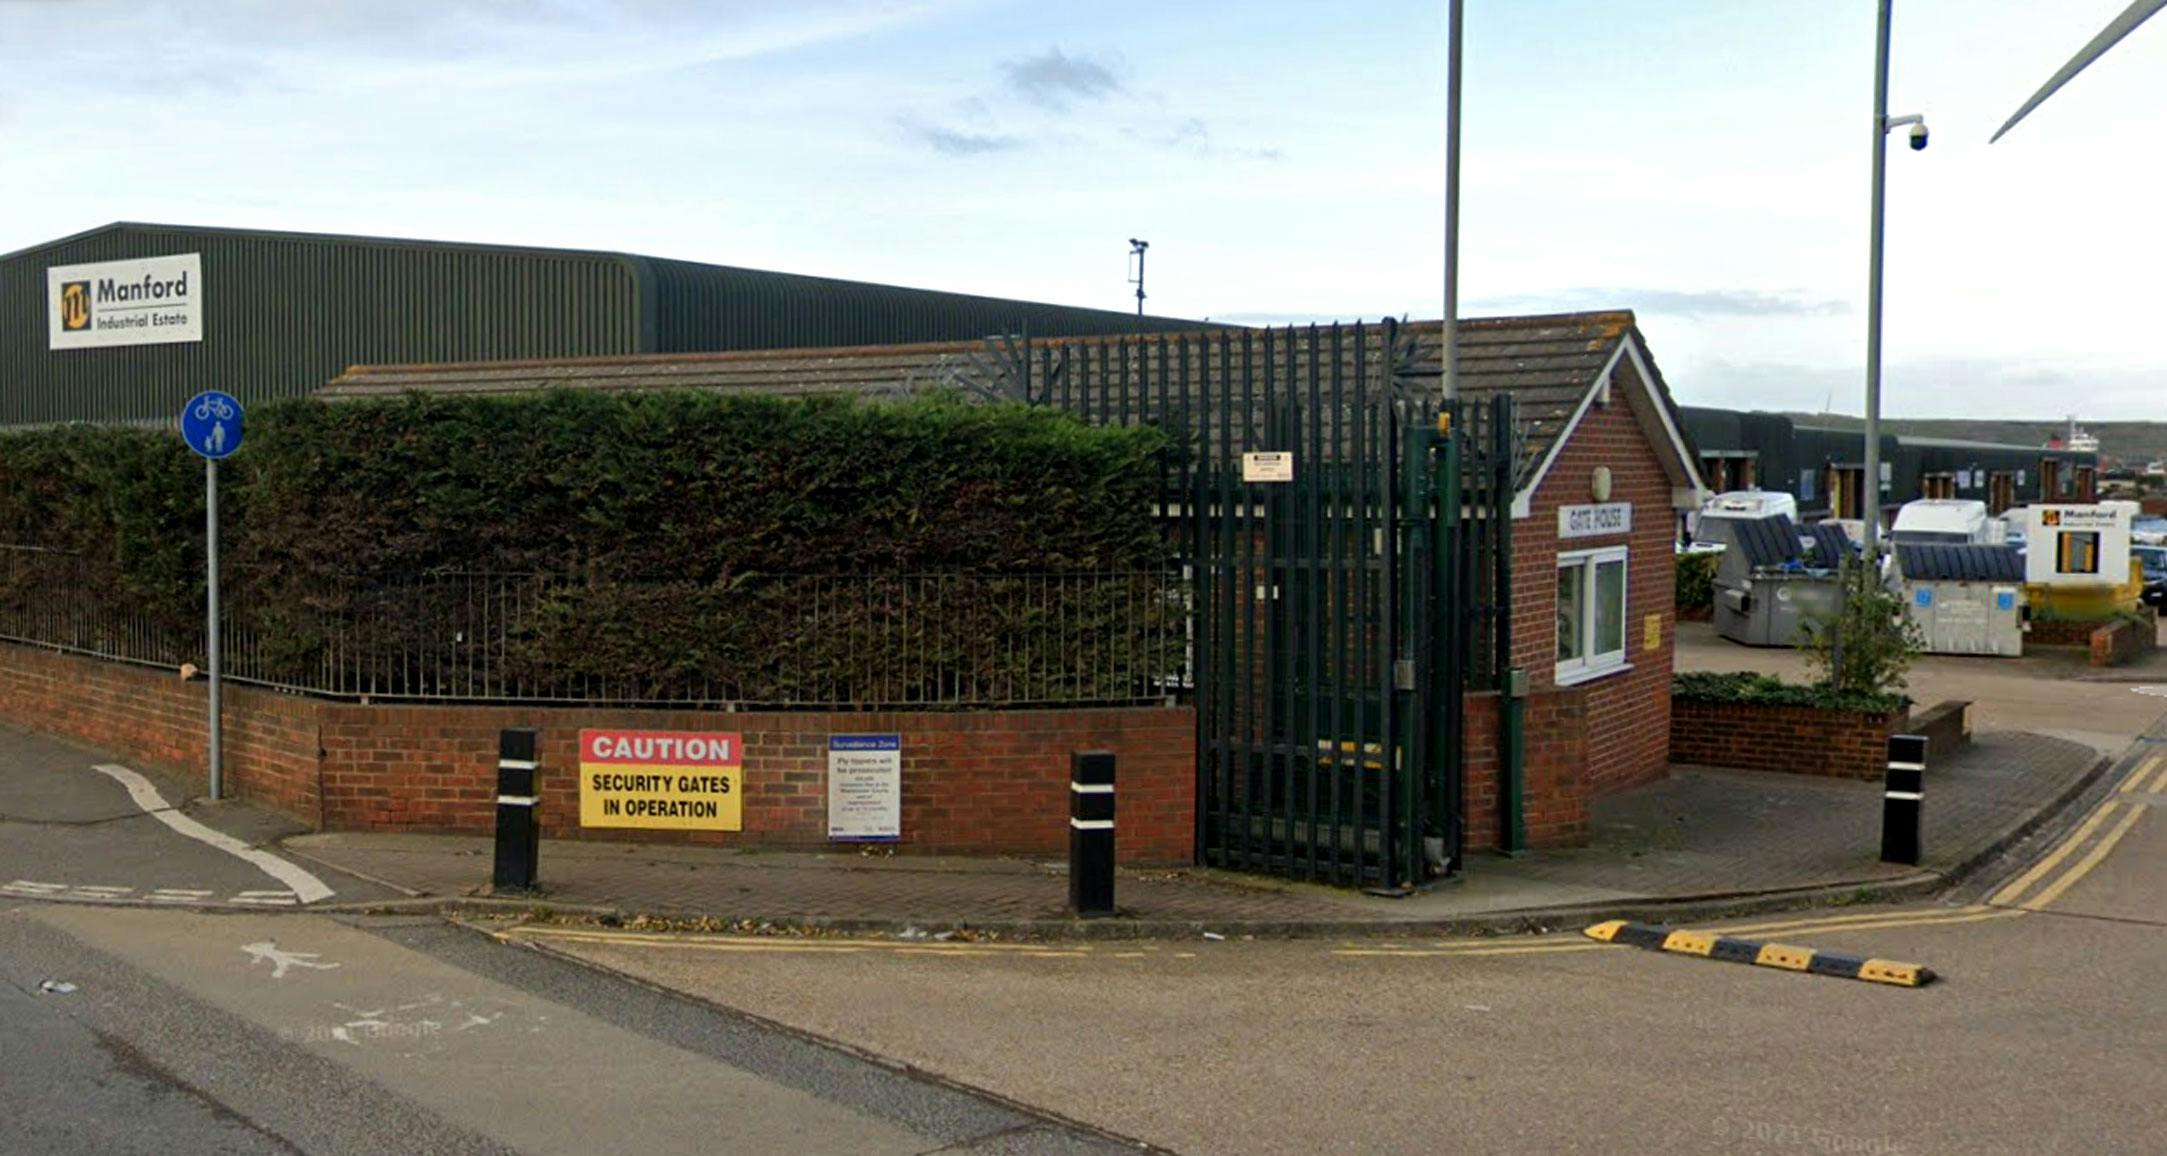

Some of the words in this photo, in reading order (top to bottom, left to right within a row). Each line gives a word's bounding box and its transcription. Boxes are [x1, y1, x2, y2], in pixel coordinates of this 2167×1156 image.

[97, 270, 188, 303] Manford
[97, 314, 149, 331] Industrial
[152, 313, 188, 328] Estate
[1570, 509, 1592, 531] GATE
[1594, 508, 1622, 529] HOUSE
[2063, 509, 2118, 519] Manford
[592, 735, 730, 761] CAUTION
[878, 740, 898, 749] Zone
[592, 773, 673, 793] SECURITY
[678, 775, 731, 794] GATES
[603, 798, 620, 816] IN
[625, 799, 718, 819] OPERATION
